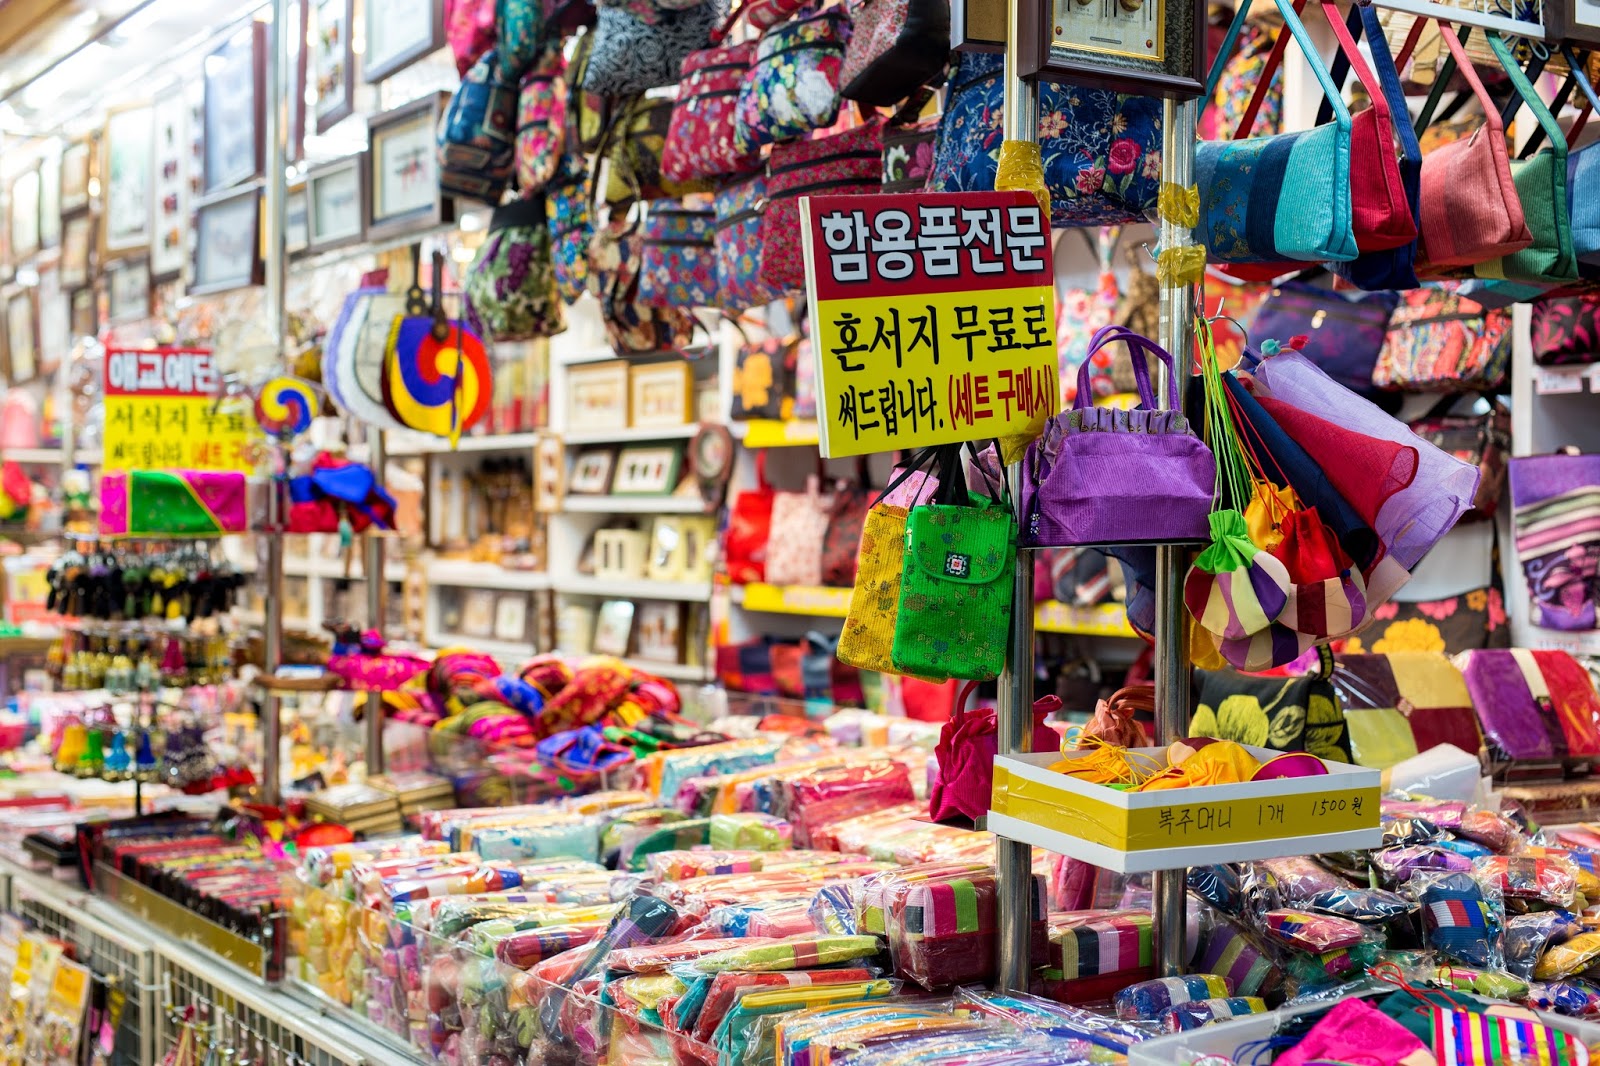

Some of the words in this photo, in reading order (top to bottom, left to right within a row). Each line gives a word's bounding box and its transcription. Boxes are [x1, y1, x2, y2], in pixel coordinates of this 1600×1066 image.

[820, 205, 1045, 282] 함용품전문
[830, 304, 940, 372] 혼서지
[951, 303, 1053, 362] 무료로
[838, 376, 944, 440] 써드립니다.
[948, 371, 994, 431] (세트
[997, 364, 1055, 422] 구매시)
[1158, 806, 1232, 835] 복주머니
[1258, 803, 1284, 825] 1개
